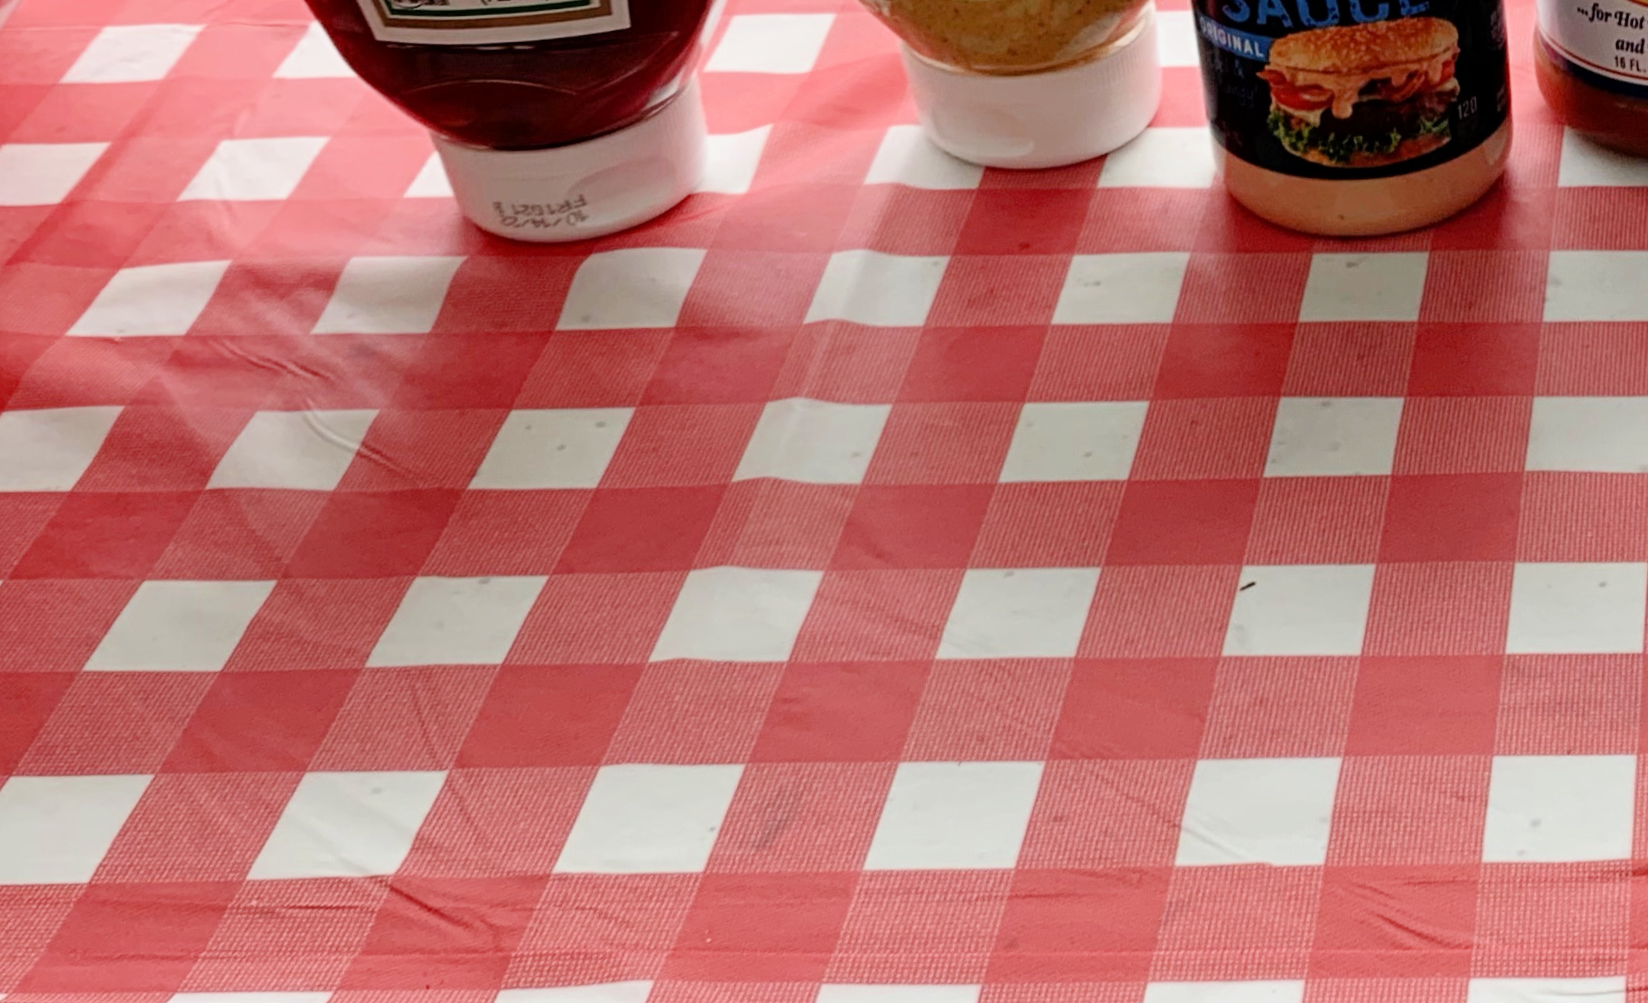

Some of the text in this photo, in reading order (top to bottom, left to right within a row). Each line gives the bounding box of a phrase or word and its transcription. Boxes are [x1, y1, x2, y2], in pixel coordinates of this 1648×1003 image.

[1613, 9, 1645, 30] Hot
[1615, 35, 1645, 55] and
[1614, 57, 1628, 70] 16
[1456, 97, 1478, 122] 120
